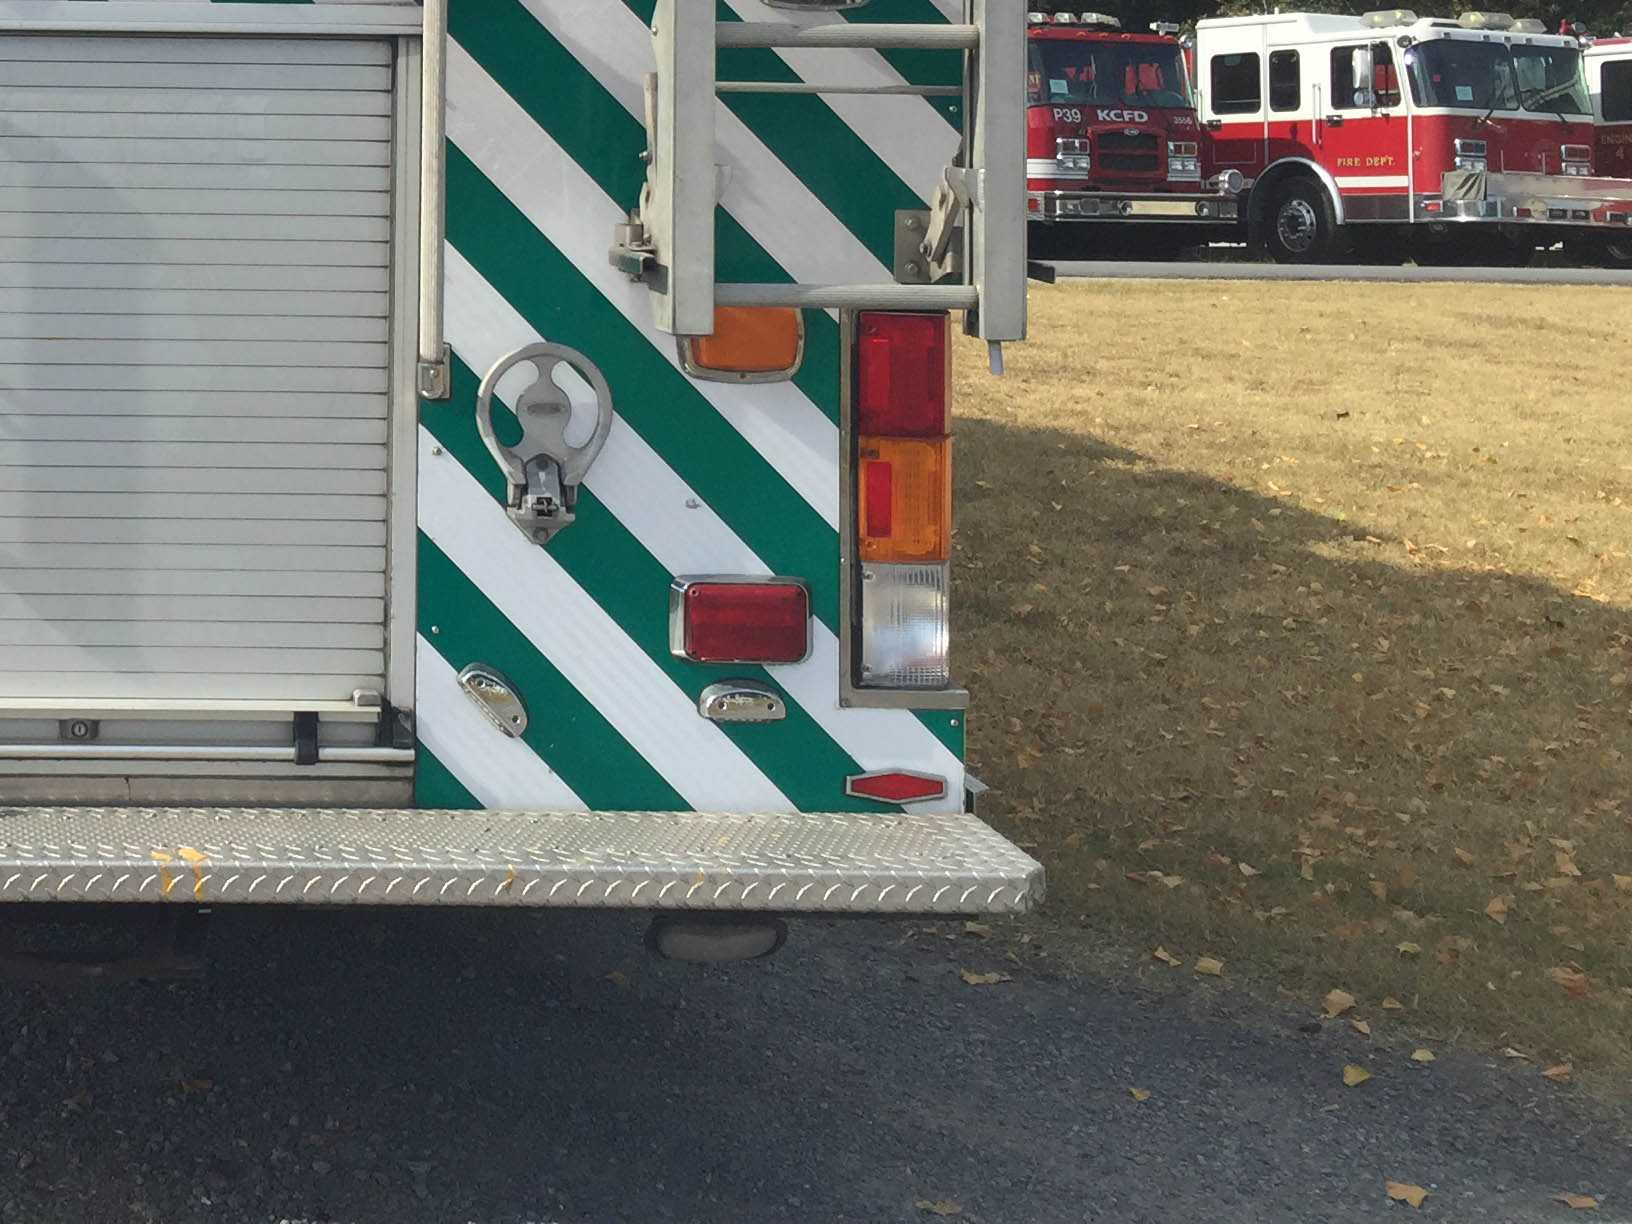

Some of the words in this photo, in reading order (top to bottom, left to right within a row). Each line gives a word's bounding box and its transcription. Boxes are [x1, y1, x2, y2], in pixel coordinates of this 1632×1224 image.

[1053, 108, 1082, 123] P39
[1096, 109, 1149, 122] KCFD
[1336, 157, 1361, 167] FIRE
